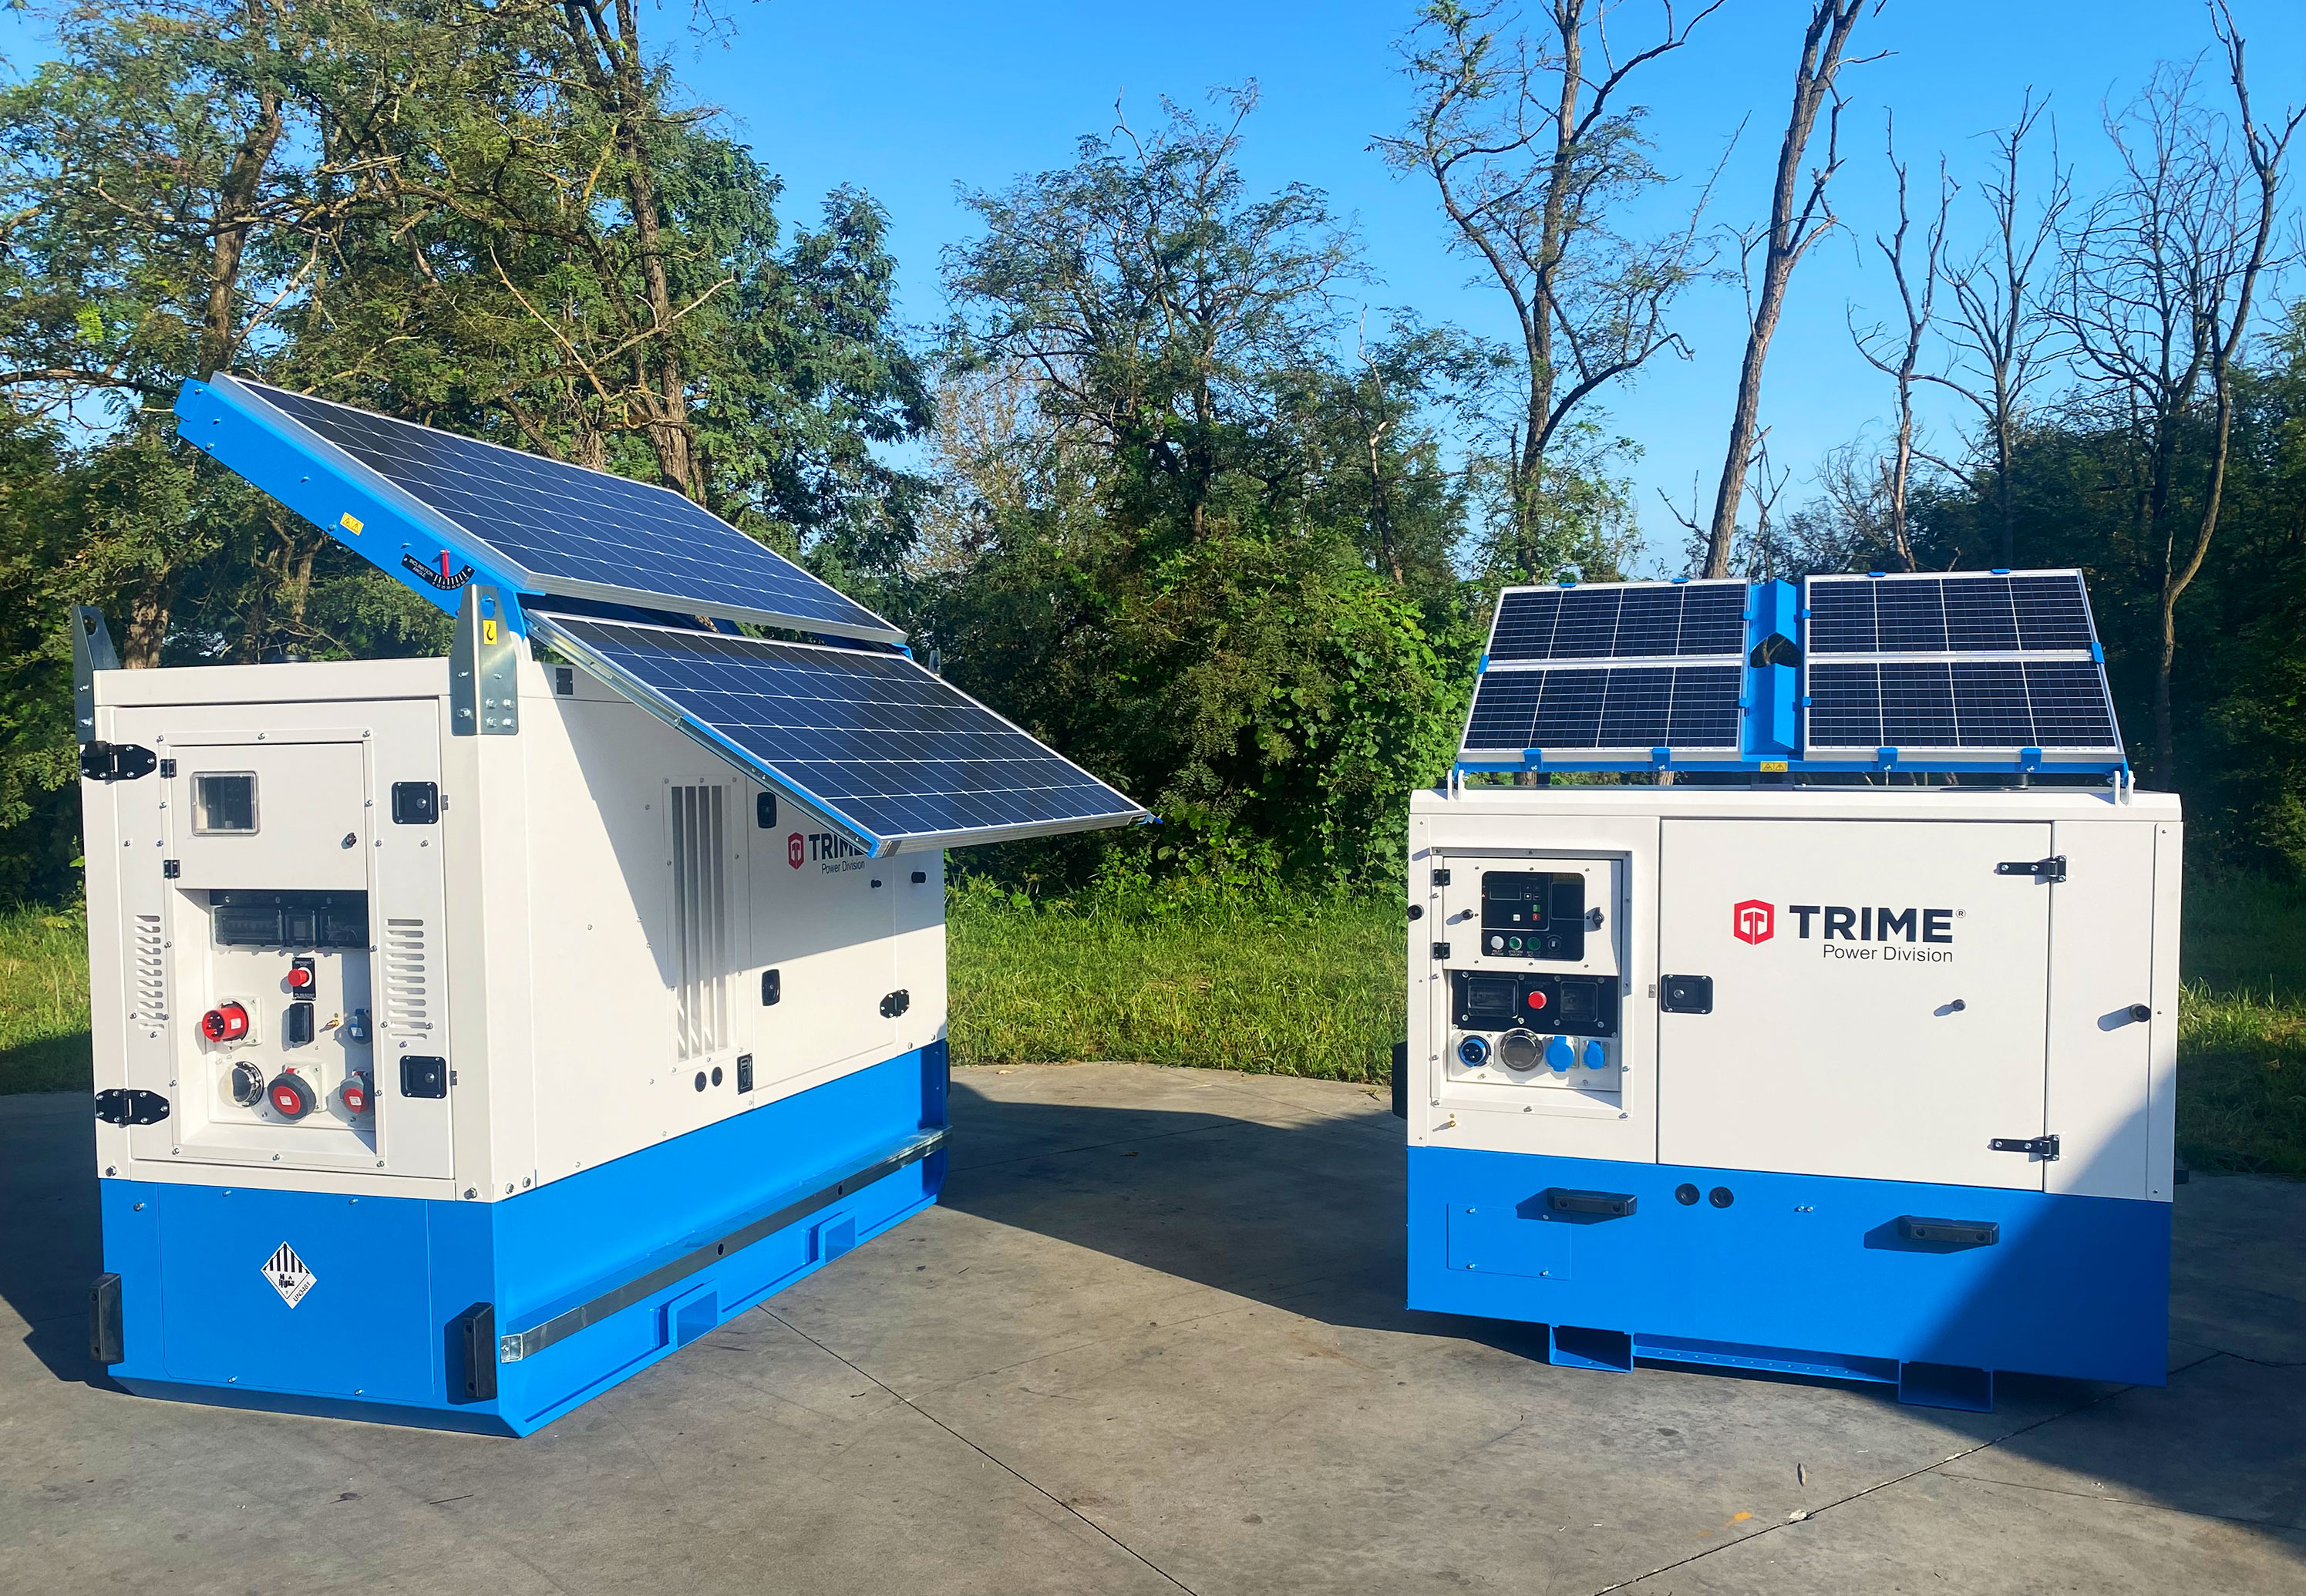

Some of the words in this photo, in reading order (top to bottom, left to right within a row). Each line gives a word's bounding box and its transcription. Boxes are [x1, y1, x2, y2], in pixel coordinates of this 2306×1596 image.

[409, 558, 433, 577] INCLINATION
[412, 567, 426, 578] ANGLE
[821, 863, 840, 875] Power
[842, 860, 865, 872] Division
[1823, 944, 1878, 960] Power
[1884, 946, 1953, 962] Division
[292, 1281, 311, 1302] UN3481
